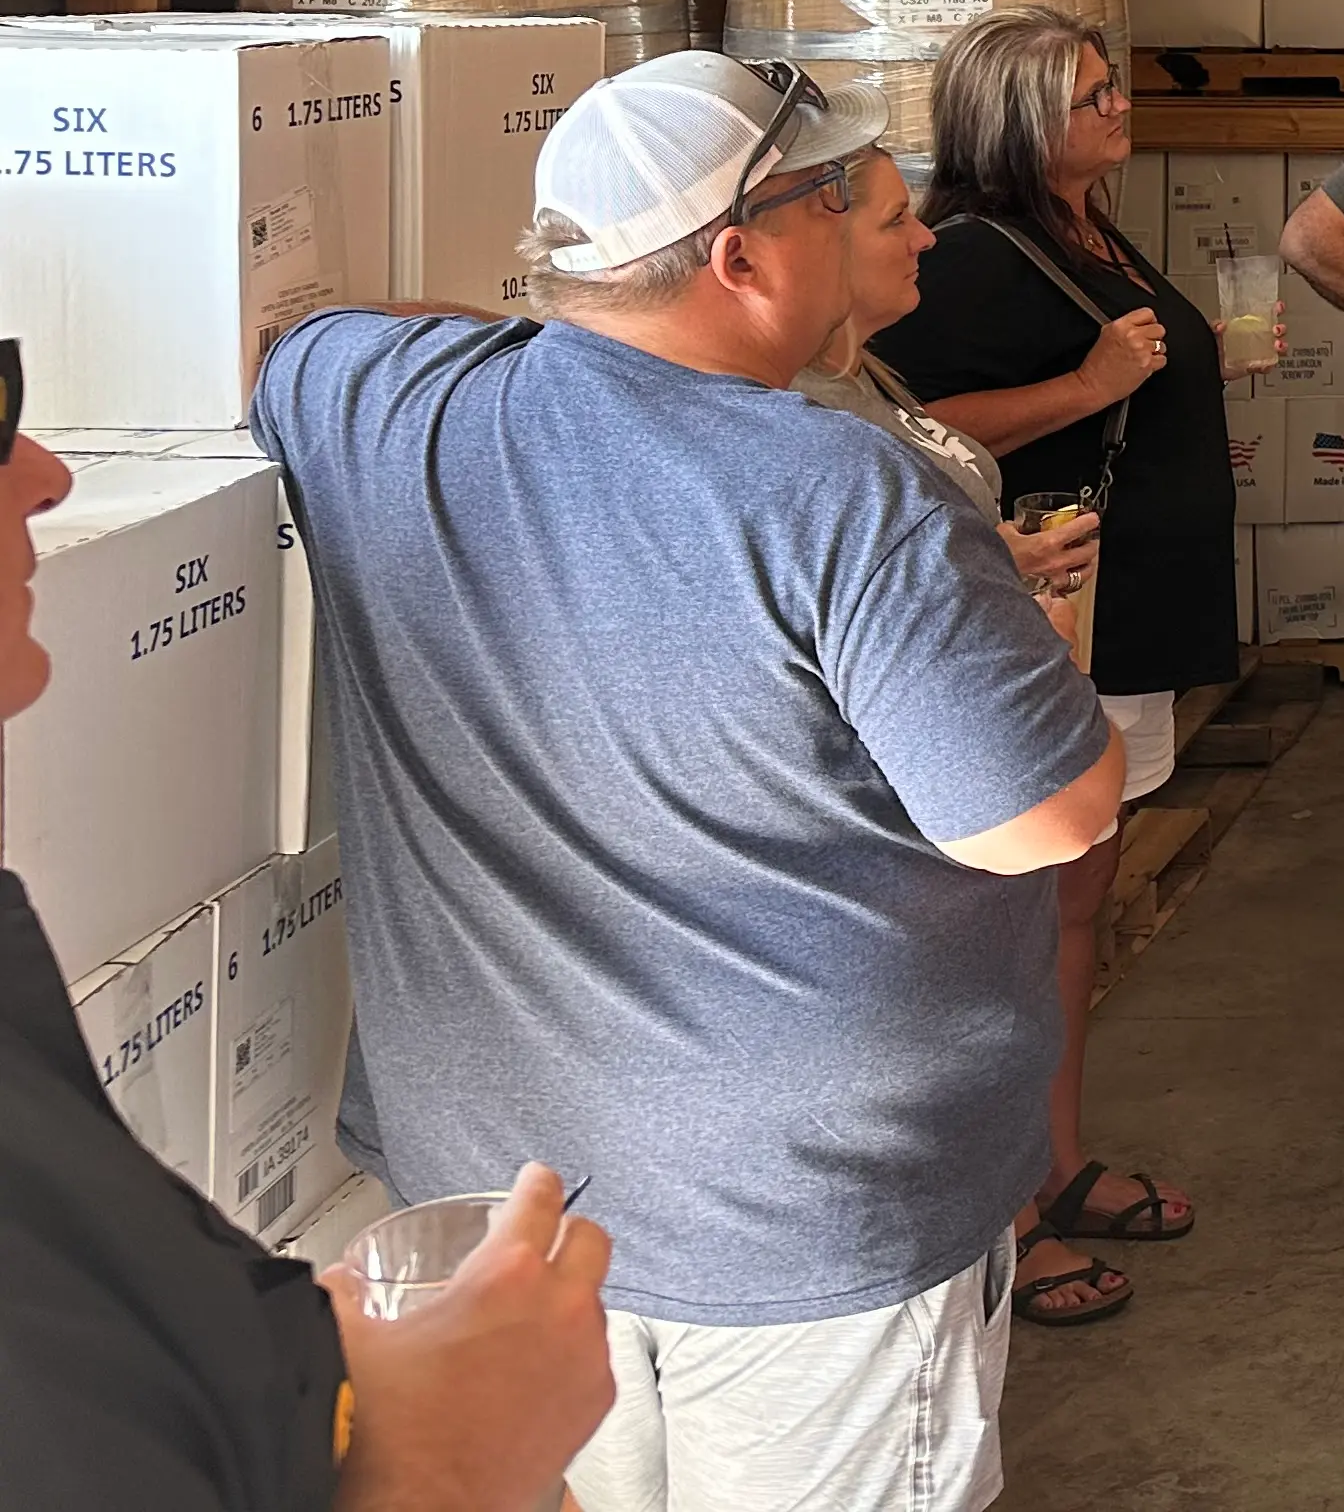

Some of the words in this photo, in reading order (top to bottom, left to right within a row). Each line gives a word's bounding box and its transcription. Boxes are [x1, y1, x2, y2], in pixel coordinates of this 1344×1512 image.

[897, 15, 906, 24] X
[911, 14, 918, 23] F
[953, 13, 961, 22] C
[532, 73, 555, 96] SIX
[52, 106, 109, 133] SIX
[251, 105, 263, 132] 6
[287, 99, 323, 128] 1.75
[327, 92, 382, 122] LITERS
[503, 110, 531, 134] 1.75
[0, 149, 53, 177] .75
[65, 150, 177, 178] LITERS
[1236, 477, 1257, 487] USA
[1313, 476, 1340, 486] Made
[175, 554, 210, 594] SIX
[130, 615, 174, 660] 1.75
[179, 585, 246, 639] LITERS
[228, 951, 238, 981] 6
[262, 908, 296, 957] 1.75
[300, 877, 343, 929] LITER
[102, 1030, 142, 1088] 1.75
[146, 981, 205, 1052] LITERS
[263, 1154, 276, 1178] IA
